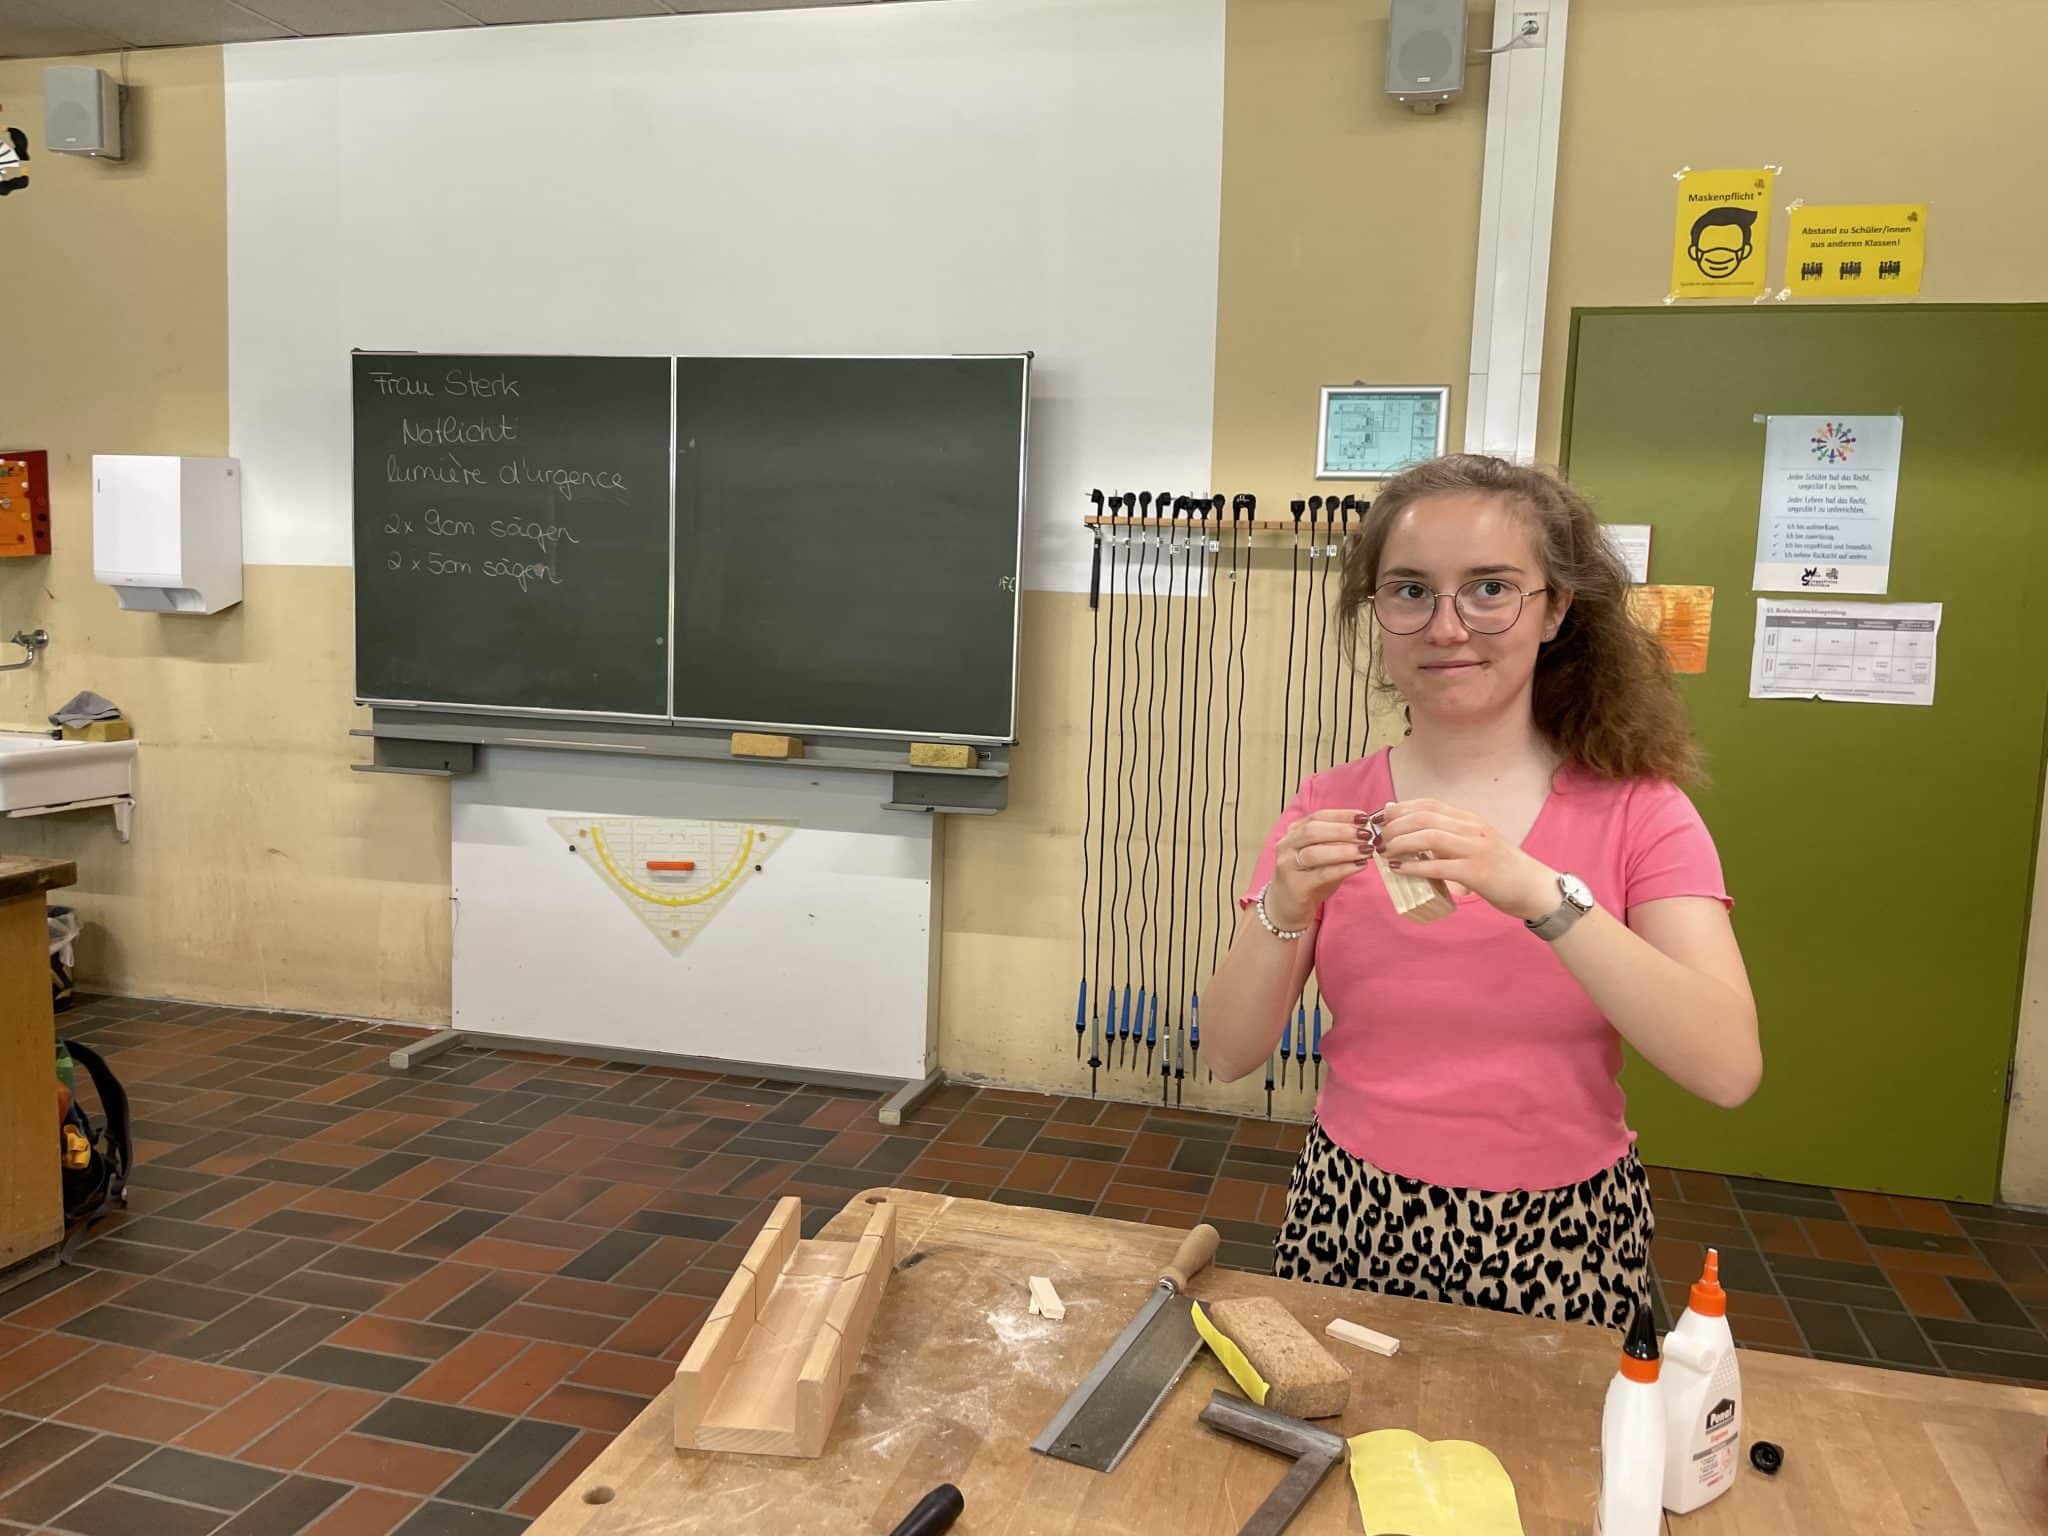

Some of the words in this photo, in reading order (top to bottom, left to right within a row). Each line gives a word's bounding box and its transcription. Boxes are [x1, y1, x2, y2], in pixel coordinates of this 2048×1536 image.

[1688, 192, 1754, 203] Maskenpflicht
[1801, 226, 1837, 235] Abstand
[1839, 227, 1849, 235] zu
[1851, 225, 1911, 235] Schüler/innen
[1810, 240, 1826, 248] aus
[1827, 239, 1863, 248] anderen
[368, 371, 435, 397] Frau
[444, 369, 520, 398] Sterk
[386, 451, 488, 485] lumière
[488, 515, 580, 552] sägen
